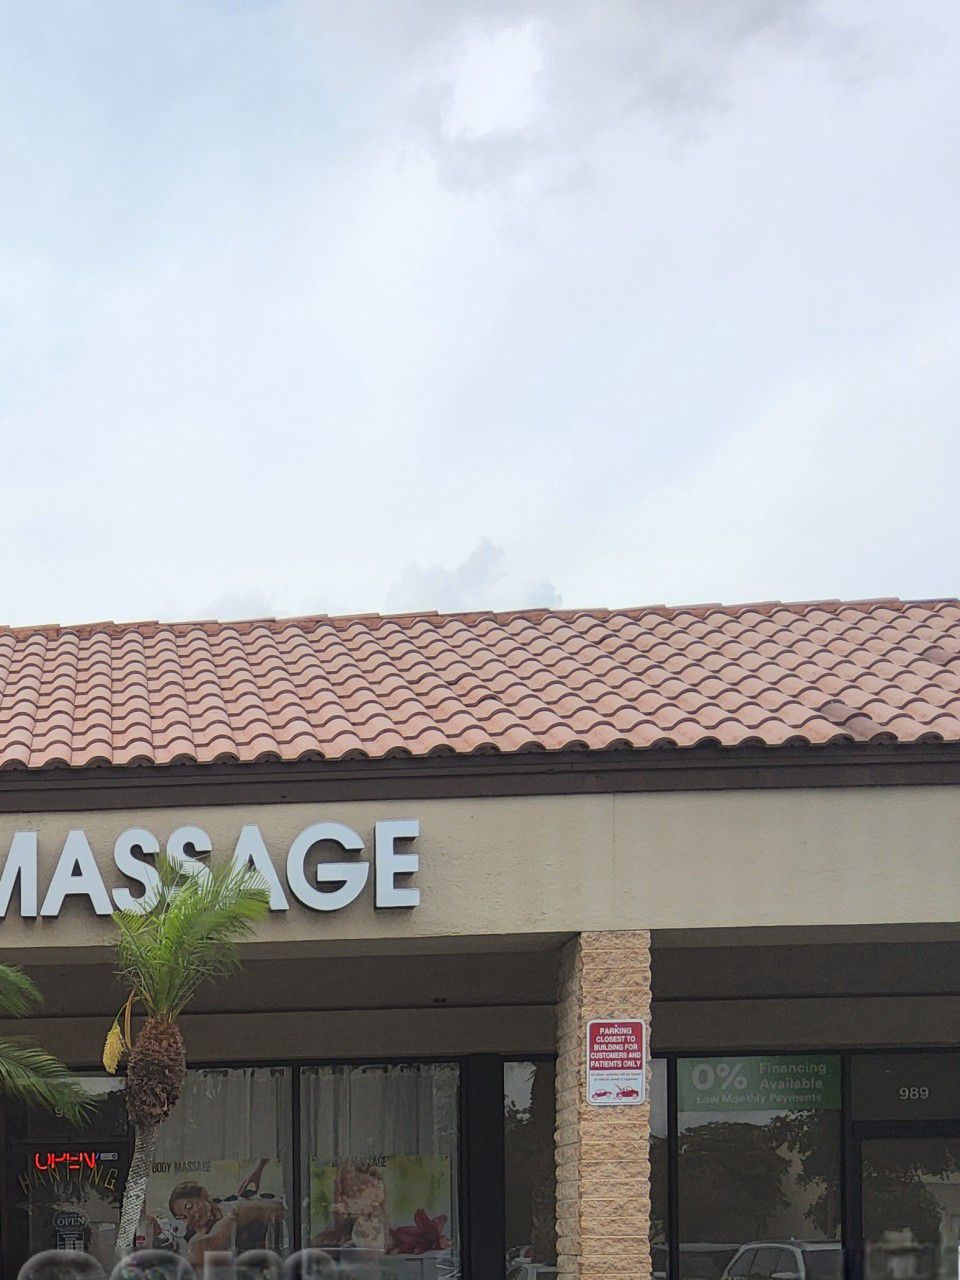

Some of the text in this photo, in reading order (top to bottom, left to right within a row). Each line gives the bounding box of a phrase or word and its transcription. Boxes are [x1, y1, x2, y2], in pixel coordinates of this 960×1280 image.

[599, 1027, 632, 1035] PARKING
[590, 1060, 622, 1068] PATIENTS
[759, 1062, 827, 1075] Financing
[692, 1063, 748, 1091] 0%
[759, 1078, 824, 1090] Available
[721, 1094, 768, 1105] Monthly
[769, 1093, 822, 1105] Payments
[899, 1086, 929, 1100] 989
[151, 1161, 172, 1174] BODY
[57, 1217, 86, 1226] OPEN
